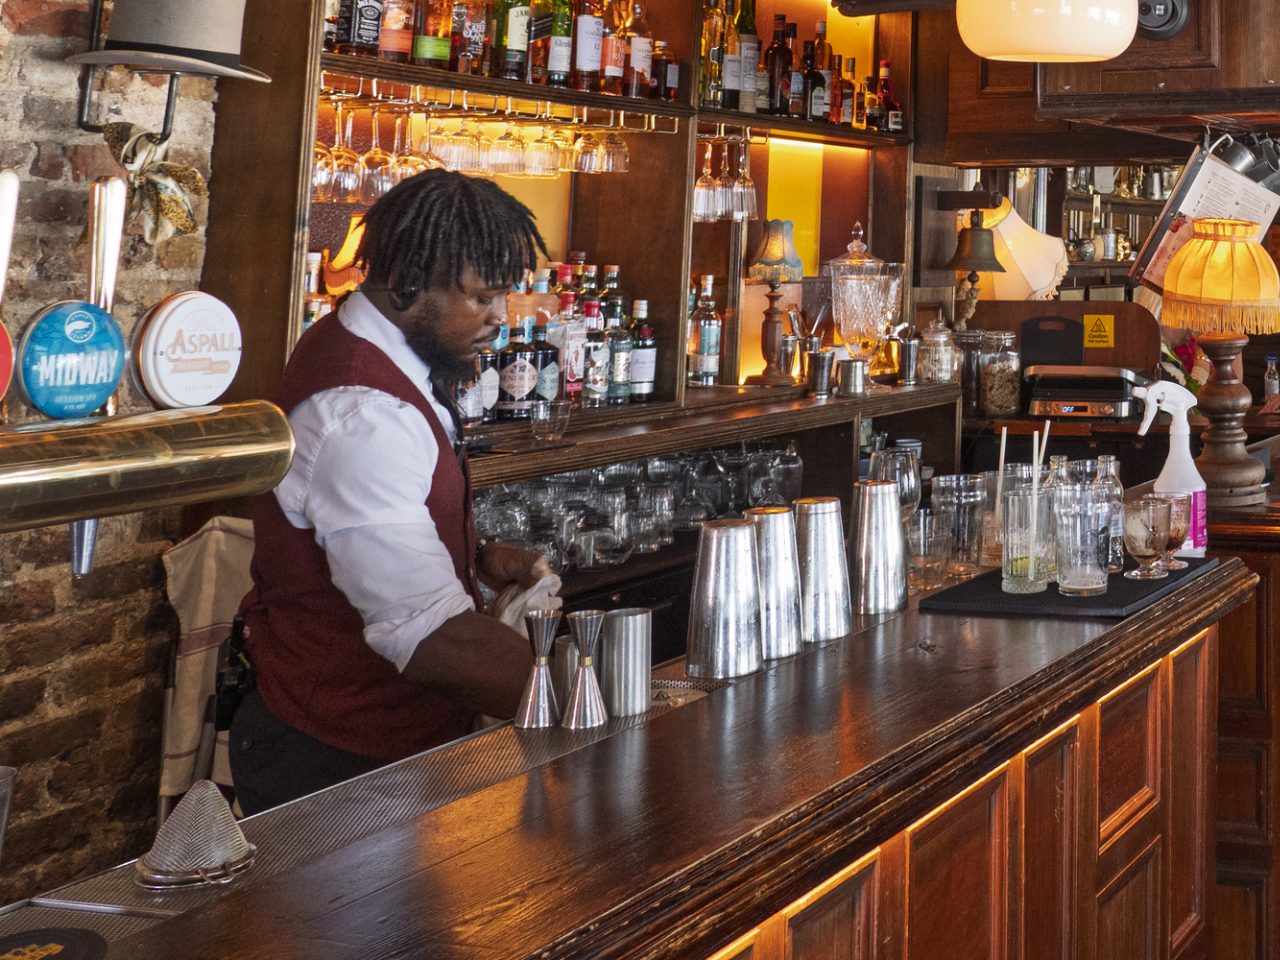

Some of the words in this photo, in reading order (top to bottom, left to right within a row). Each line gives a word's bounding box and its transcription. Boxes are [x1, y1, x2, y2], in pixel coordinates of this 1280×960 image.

[167, 329, 237, 357] ASPALL
[39, 349, 119, 387] MIDWAY
[1062, 405, 1075, 413] OFF
